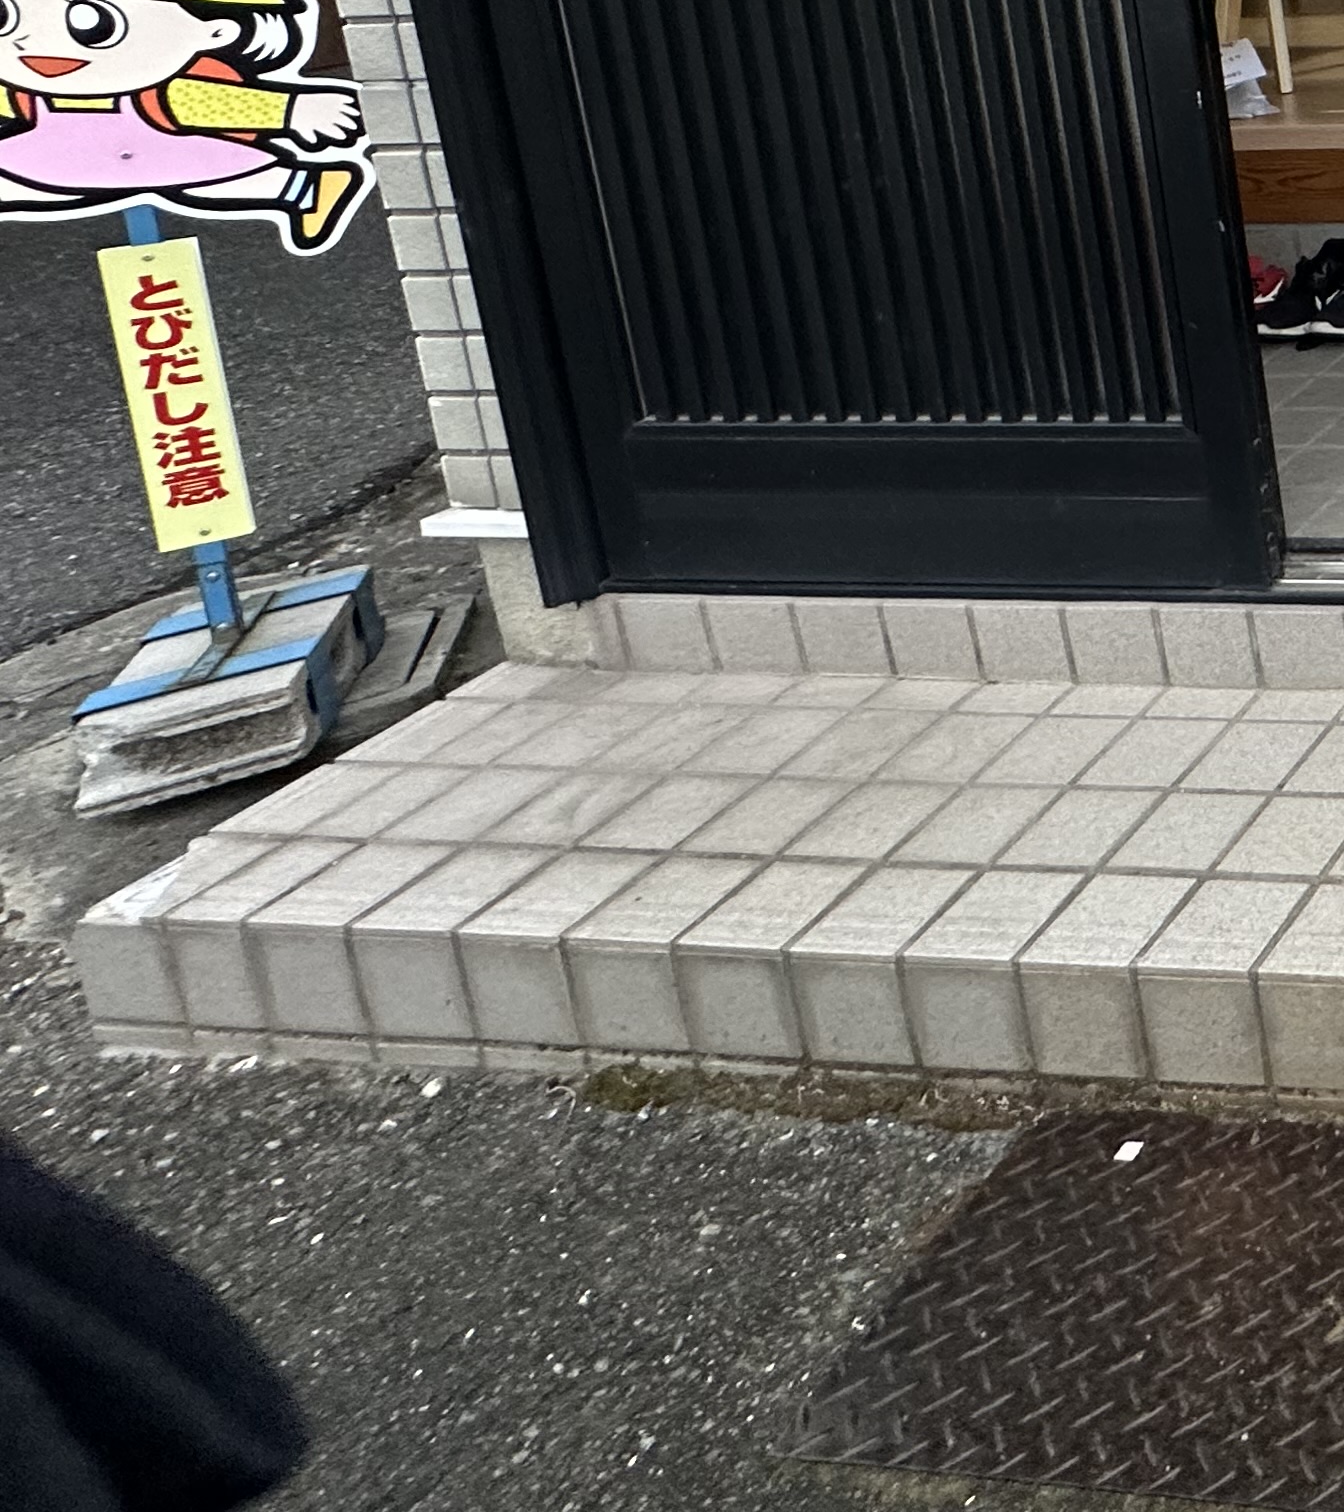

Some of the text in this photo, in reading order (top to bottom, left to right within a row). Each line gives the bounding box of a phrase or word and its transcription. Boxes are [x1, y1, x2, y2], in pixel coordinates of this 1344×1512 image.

[129, 274, 230, 509] とびだし注意
